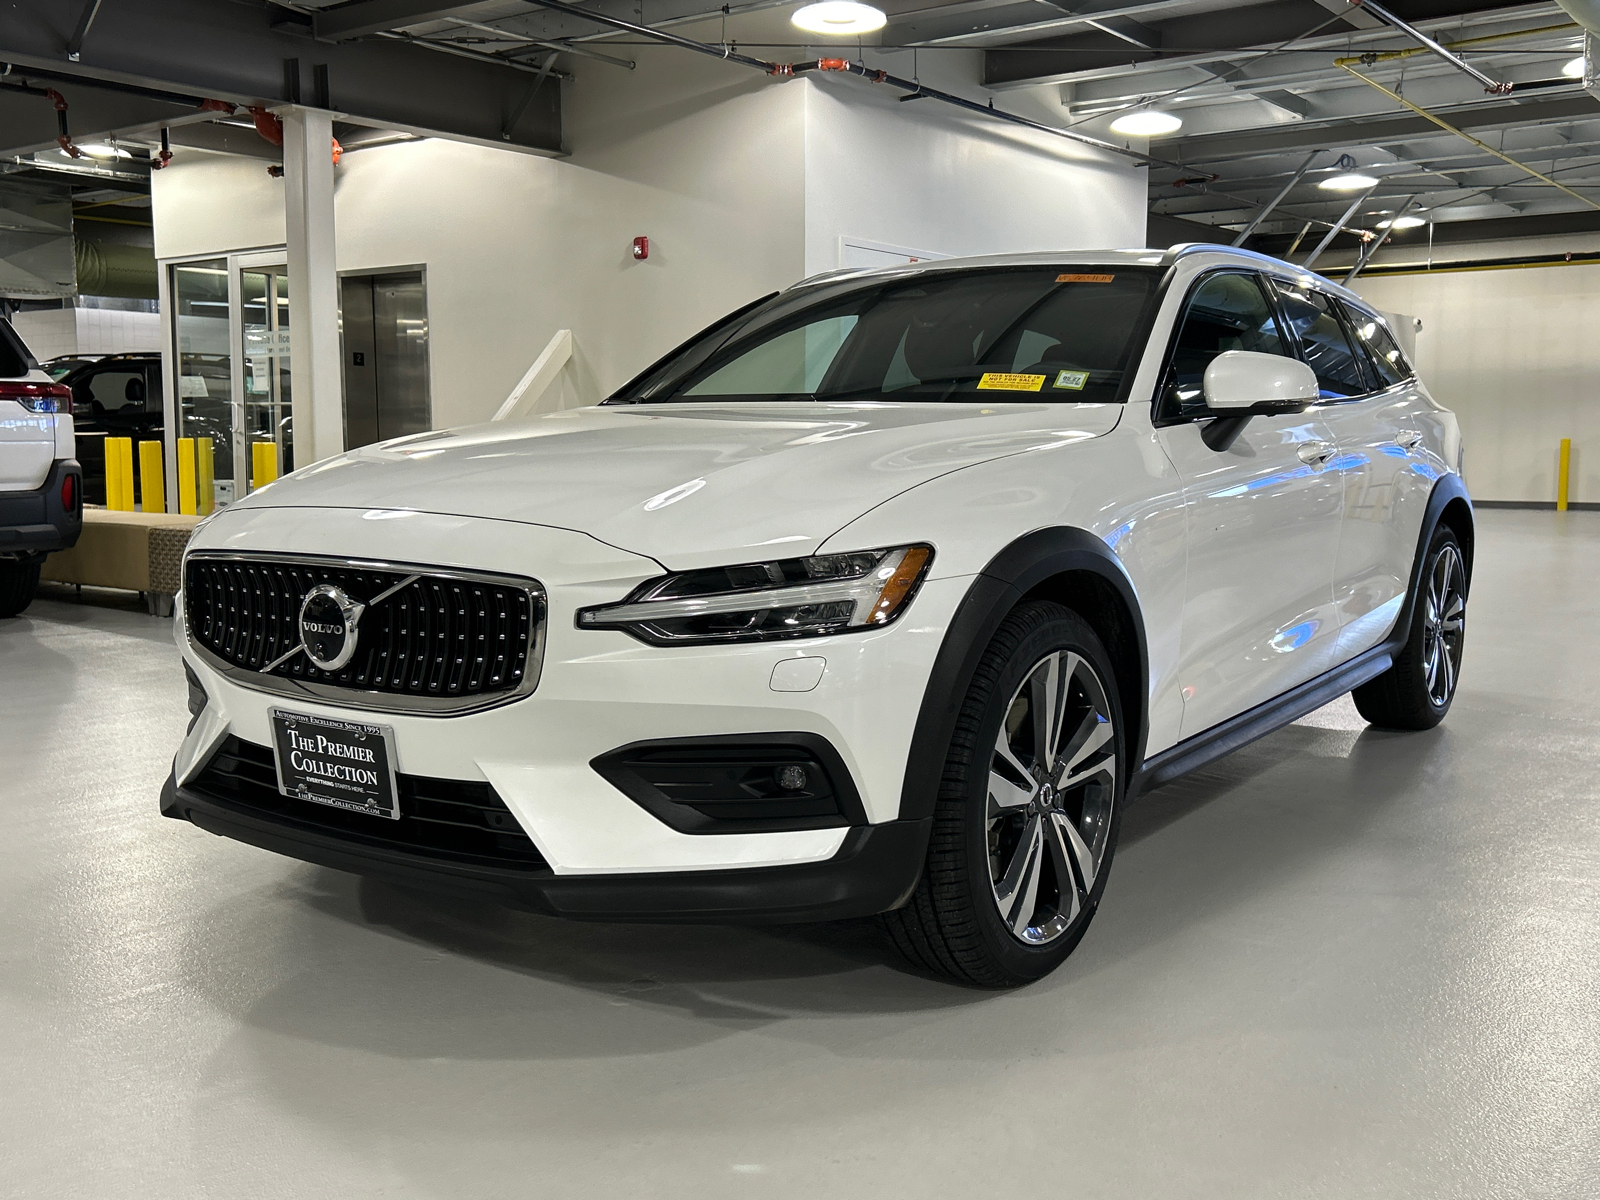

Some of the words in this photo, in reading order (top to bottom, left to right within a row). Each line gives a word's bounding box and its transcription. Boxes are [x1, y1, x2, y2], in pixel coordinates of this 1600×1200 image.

[303, 621, 343, 634] VOLVO
[275, 710, 309, 722] AUTOMOTIVE
[310, 716, 344, 728] EXCELLENCE
[344, 722, 361, 731] SINCE
[363, 725, 380, 734] 1995
[287, 729, 316, 753] THE
[316, 734, 376, 763] PREMIER
[290, 750, 378, 785] COLLECTION
[306, 776, 335, 787] EVERYTHING
